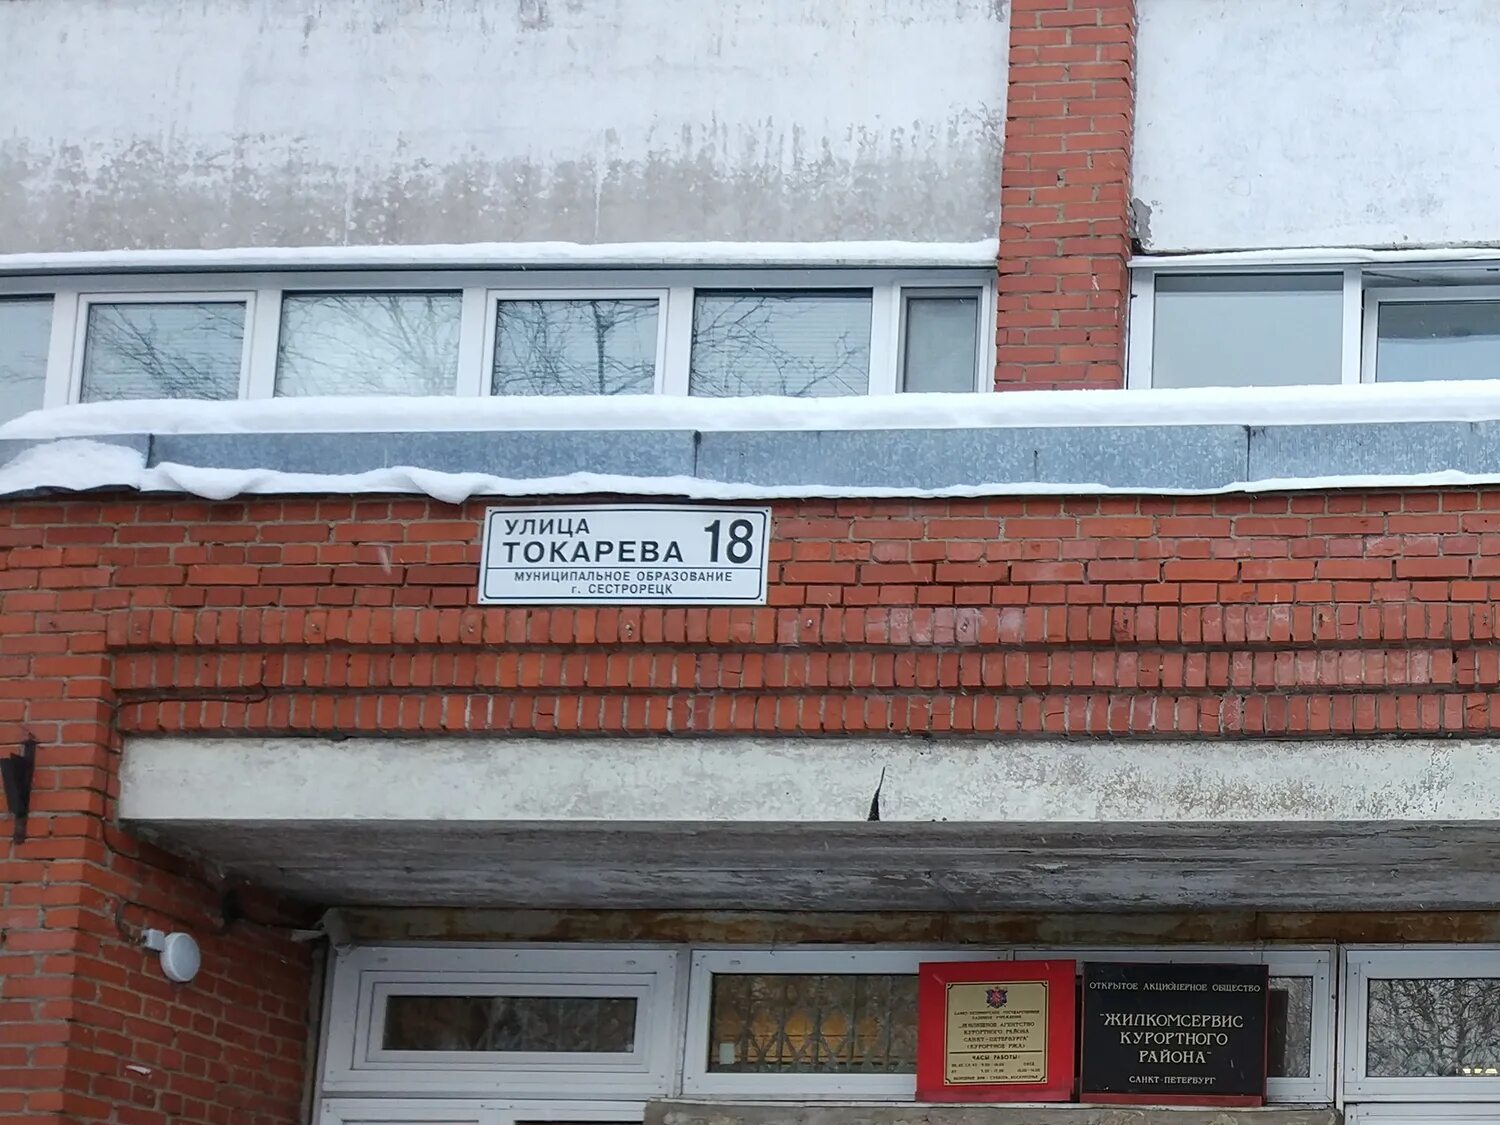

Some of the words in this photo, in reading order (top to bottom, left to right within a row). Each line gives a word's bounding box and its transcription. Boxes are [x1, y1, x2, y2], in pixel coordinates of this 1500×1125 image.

[504, 518, 590, 536] УЛИЦА
[704, 518, 754, 564] 18
[503, 541, 684, 563] ТОКАРЕВА
[514, 571, 631, 583] МУНИЦИПАЛЬНОЕ
[637, 571, 733, 582] ОБРАЗОВАНИЕ
[571, 586, 581, 594] г.
[588, 584, 673, 596] СЕСТРОРЕЦК
[1089, 982, 1139, 990] ОТКРЫТОЕ
[1143, 982, 1208, 992] АКЦИОНЕРНОЕ
[1211, 983, 1261, 993] ОБЩЕСТВО
[1119, 1031, 1228, 1045] КУРОРТНОГО
